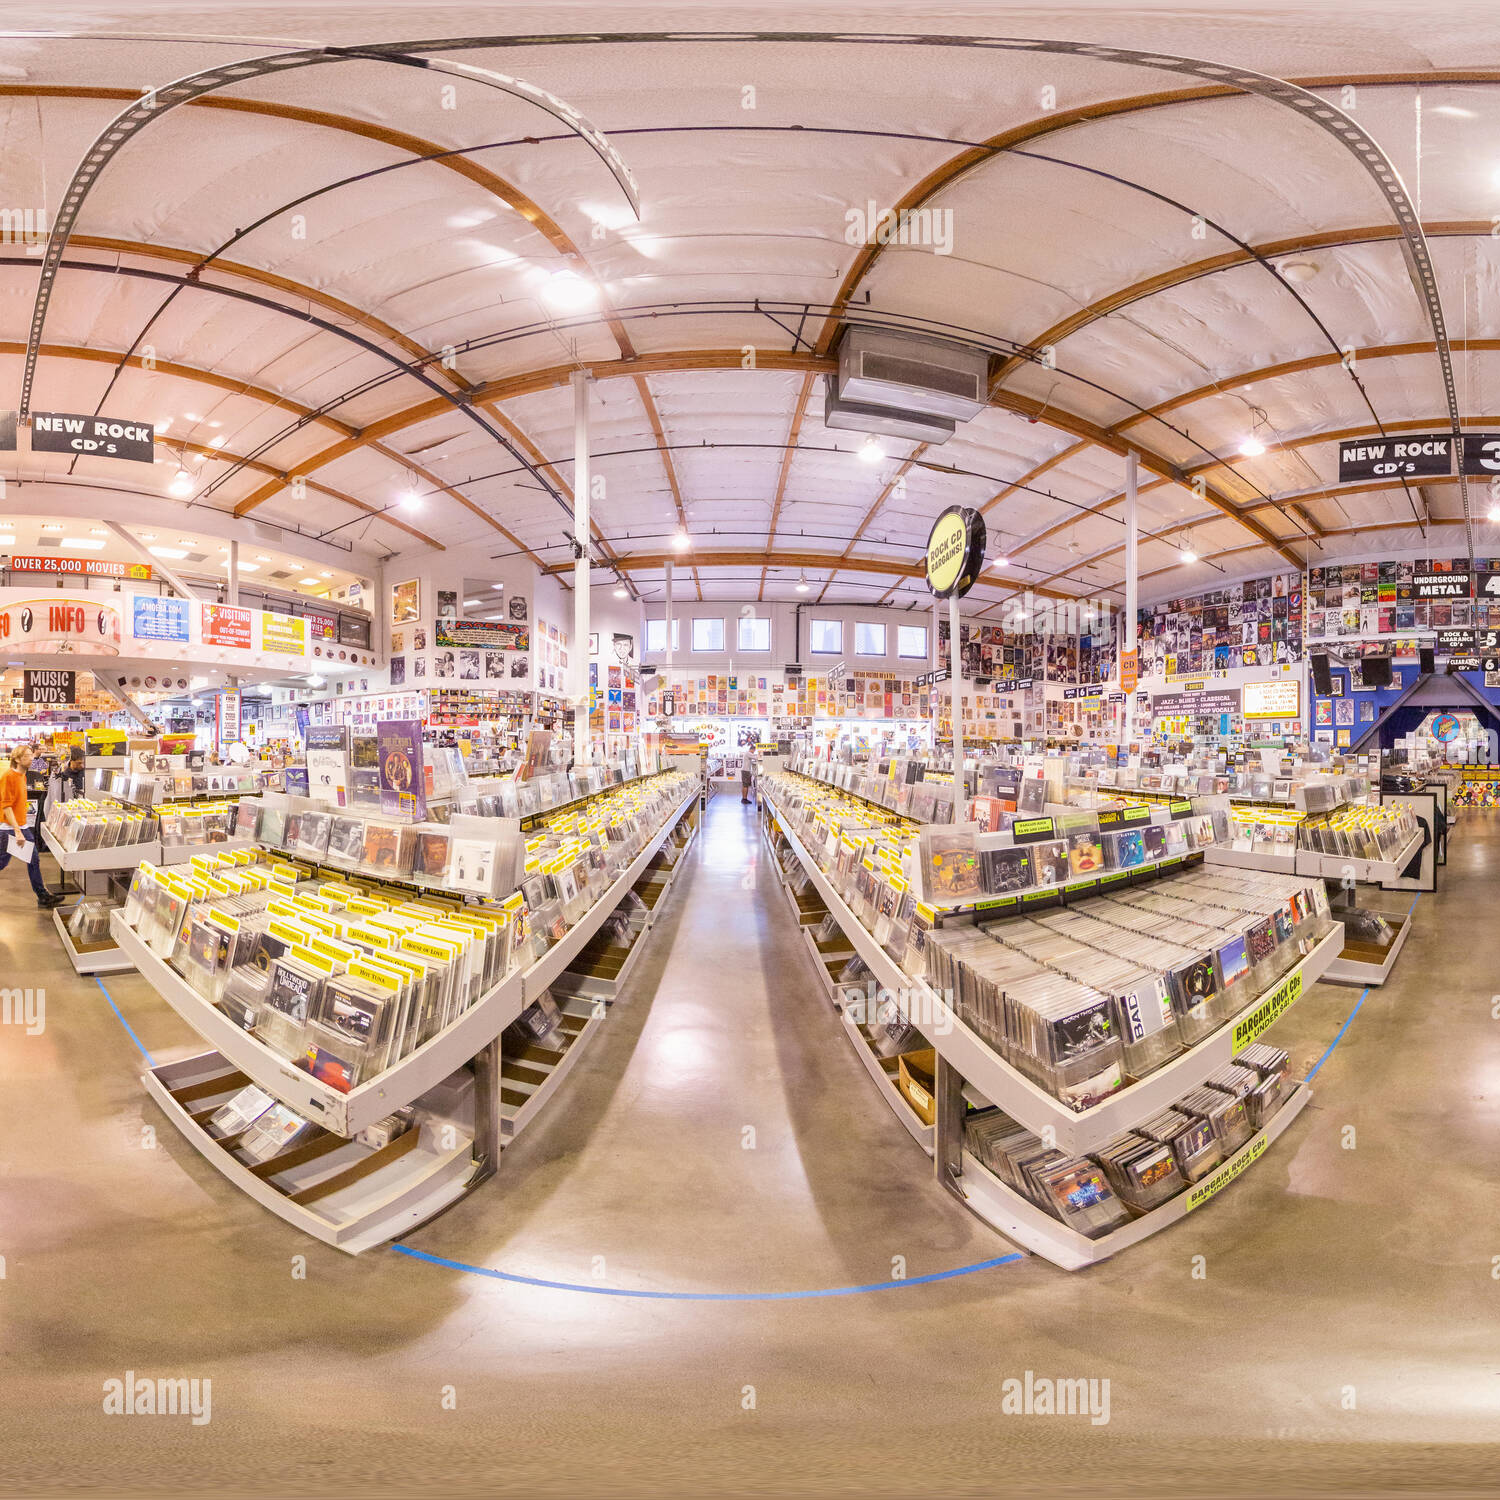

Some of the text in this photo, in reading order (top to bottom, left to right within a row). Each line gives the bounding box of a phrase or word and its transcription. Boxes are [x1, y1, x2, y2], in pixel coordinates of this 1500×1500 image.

[35, 417, 150, 442] NEW ROCK
[71, 438, 117, 453] CD's
[1343, 442, 1447, 463] NEW ROCK
[1372, 461, 1416, 475] CD's
[930, 529, 962, 562] ROCK CD
[14, 558, 125, 575] OVER 25,000 MOVIES
[931, 542, 963, 573] BARGAINS!
[1413, 575, 1469, 584] UNDERGROUND
[1419, 585, 1463, 596] METAL
[48, 605, 85, 634] INFO
[219, 608, 250, 622] VISITING
[1486, 632, 1497, 646] 5
[1485, 659, 1495, 670] 6
[30, 671, 69, 686] MUSIC
[33, 687, 67, 703] DVD's
[1200, 695, 1231, 703] CLASSICAL
[276, 967, 308, 990] HOLLYWOOD
[279, 975, 302, 994] UNDEAD
[371, 973, 386, 984] TUNA
[1127, 993, 1144, 1040] BAD
[1236, 976, 1301, 1042] BARGAIN ROCK CDs
[1254, 1010, 1279, 1037] UNDER
[1191, 1139, 1265, 1202] BARGAIN ROCK CDs
[1210, 1170, 1239, 1194] UNDER
